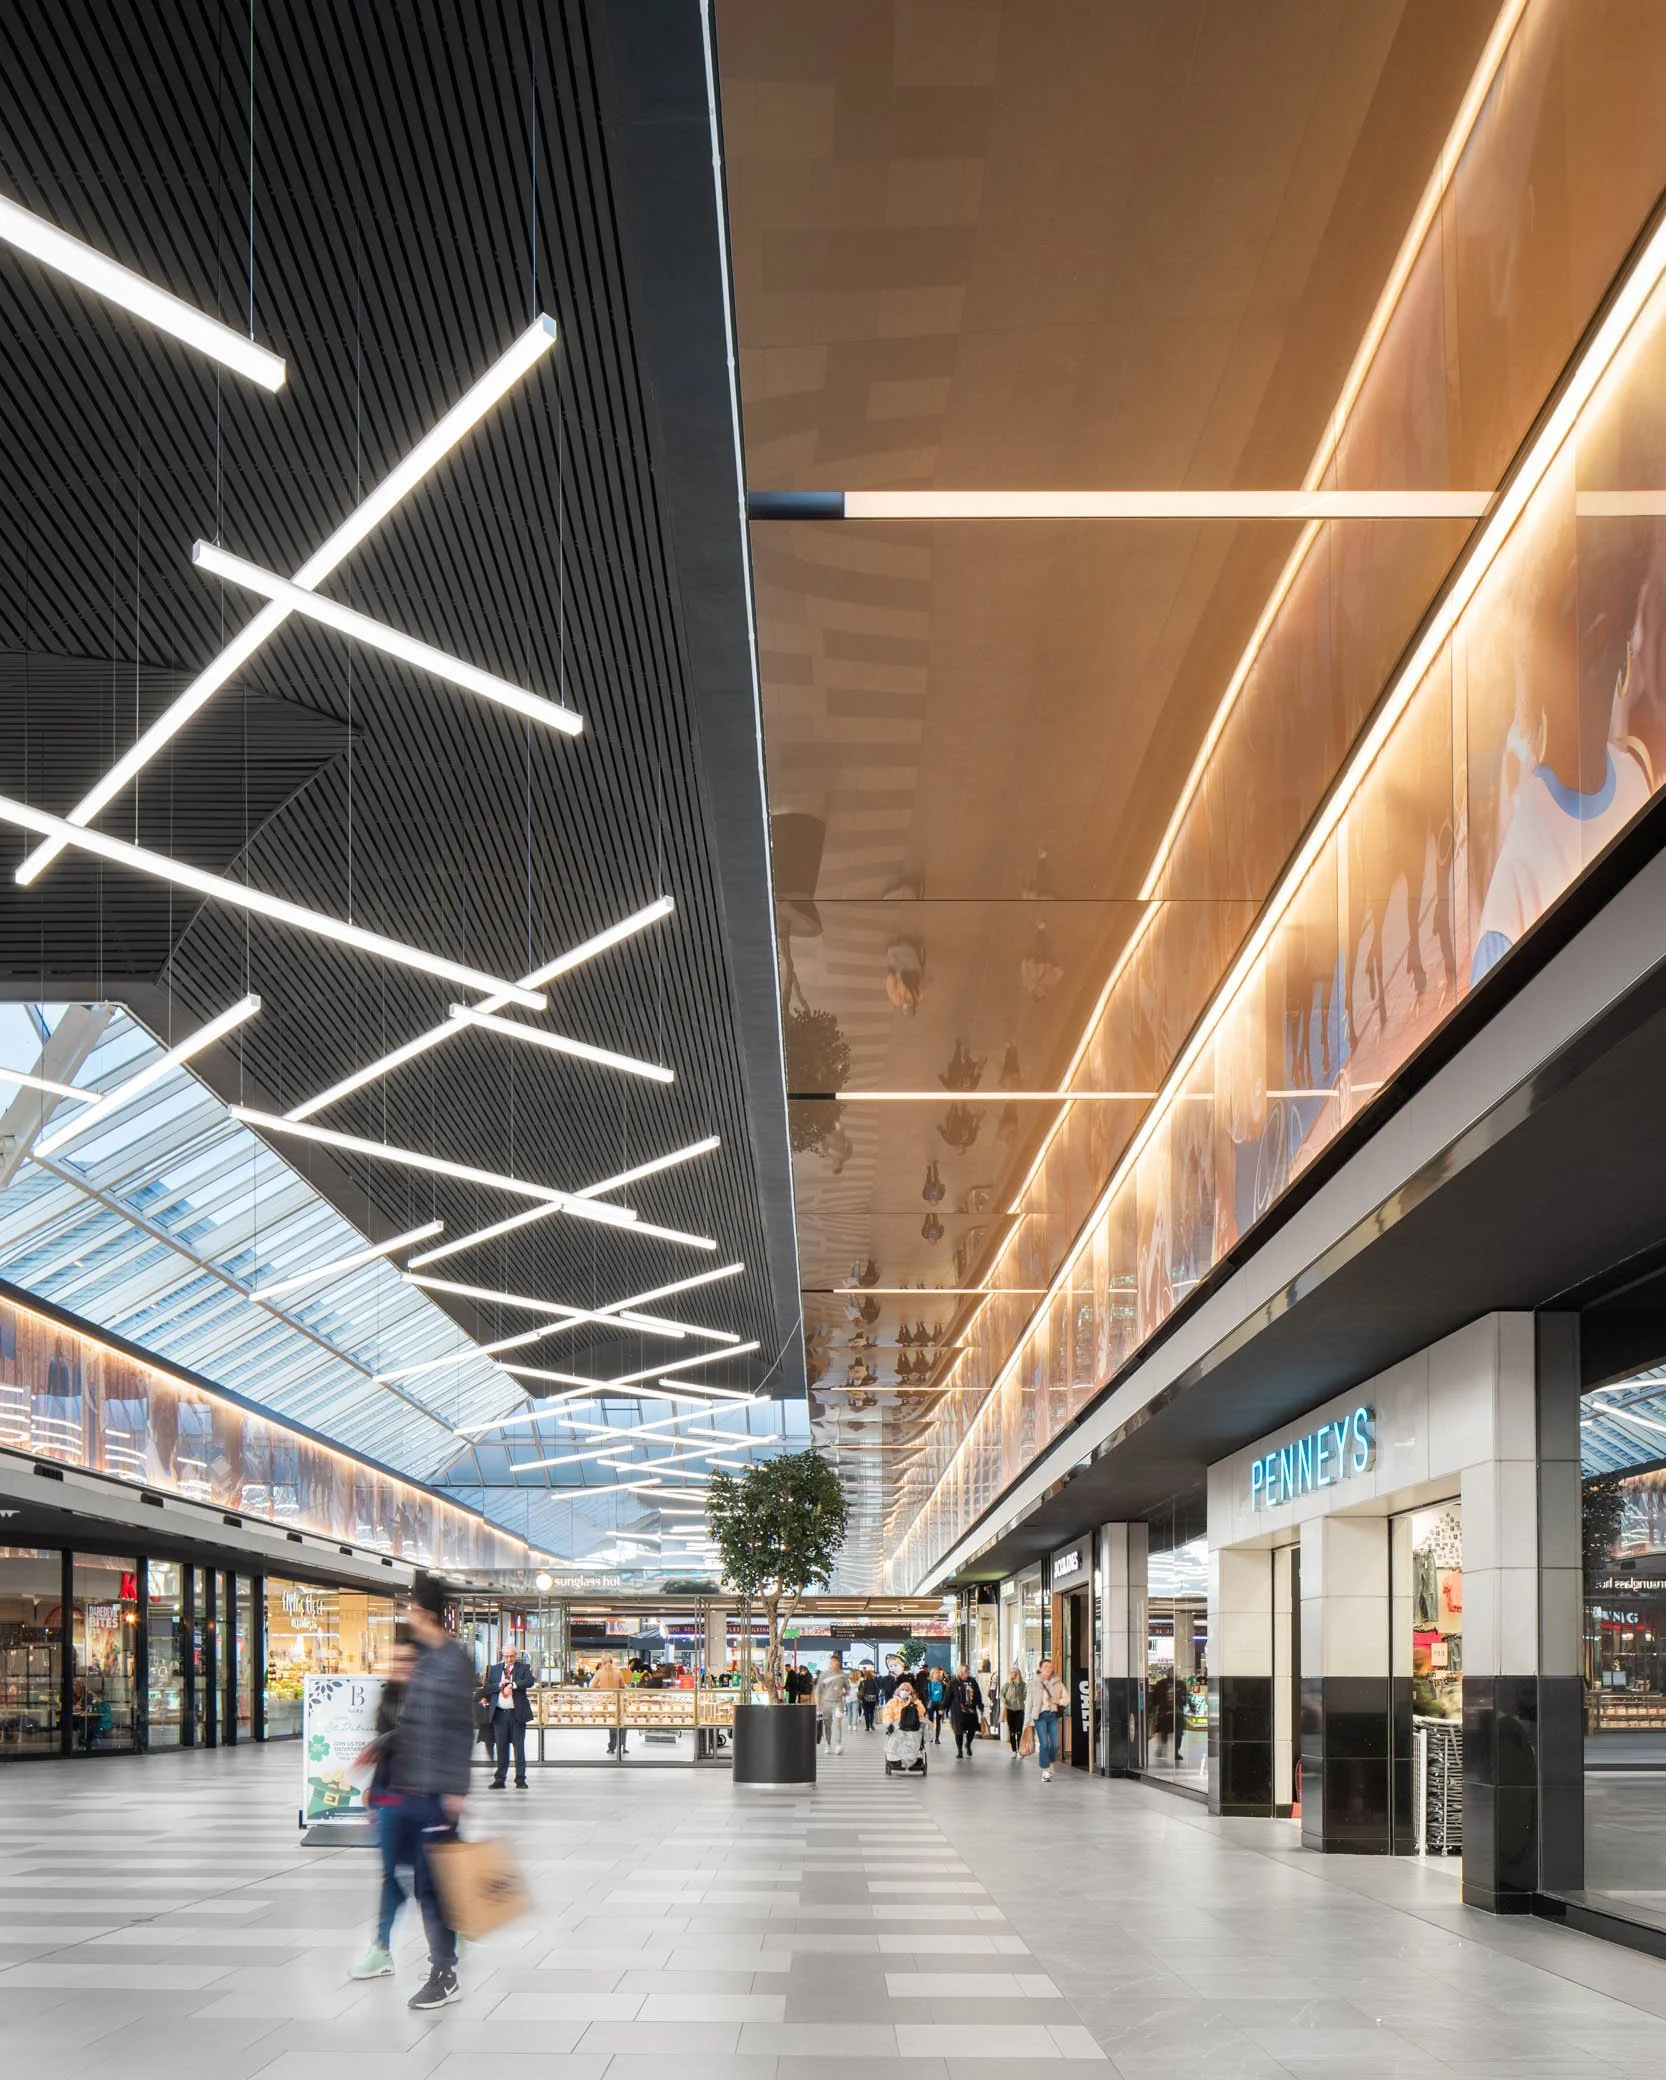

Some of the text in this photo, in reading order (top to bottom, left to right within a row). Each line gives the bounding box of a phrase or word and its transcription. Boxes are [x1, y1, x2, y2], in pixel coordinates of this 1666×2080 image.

[1251, 1406, 1370, 1512] PENNEYS
[554, 1574, 600, 1589] sunglass
[88, 1617, 119, 1629] BITES
[351, 1685, 366, 1706] B
